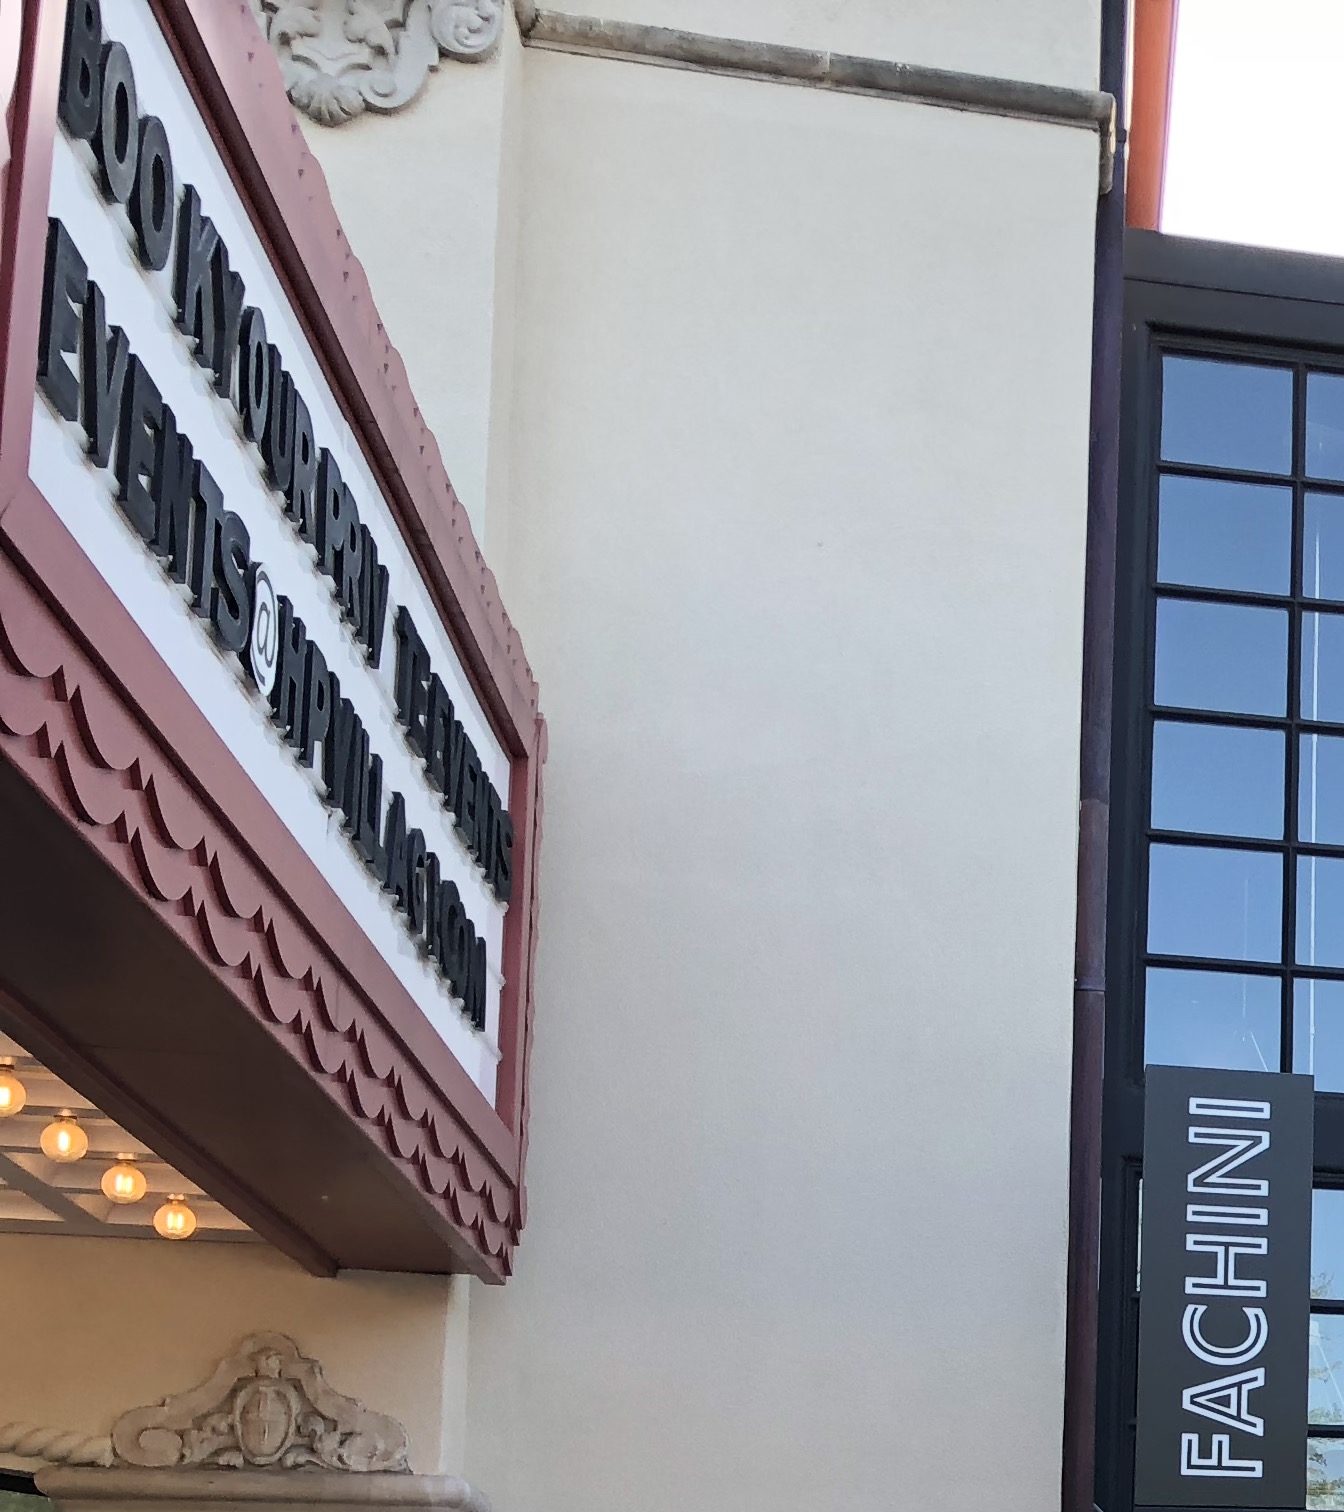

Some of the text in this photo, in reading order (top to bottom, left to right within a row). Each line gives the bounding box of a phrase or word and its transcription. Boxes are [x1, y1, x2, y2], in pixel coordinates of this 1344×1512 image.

[58, 0, 220, 370] BOOK
[212, 228, 316, 542] YOUR
[425, 672, 515, 903] EVENTS
[1180, 1096, 1271, 1479] FACHINI
